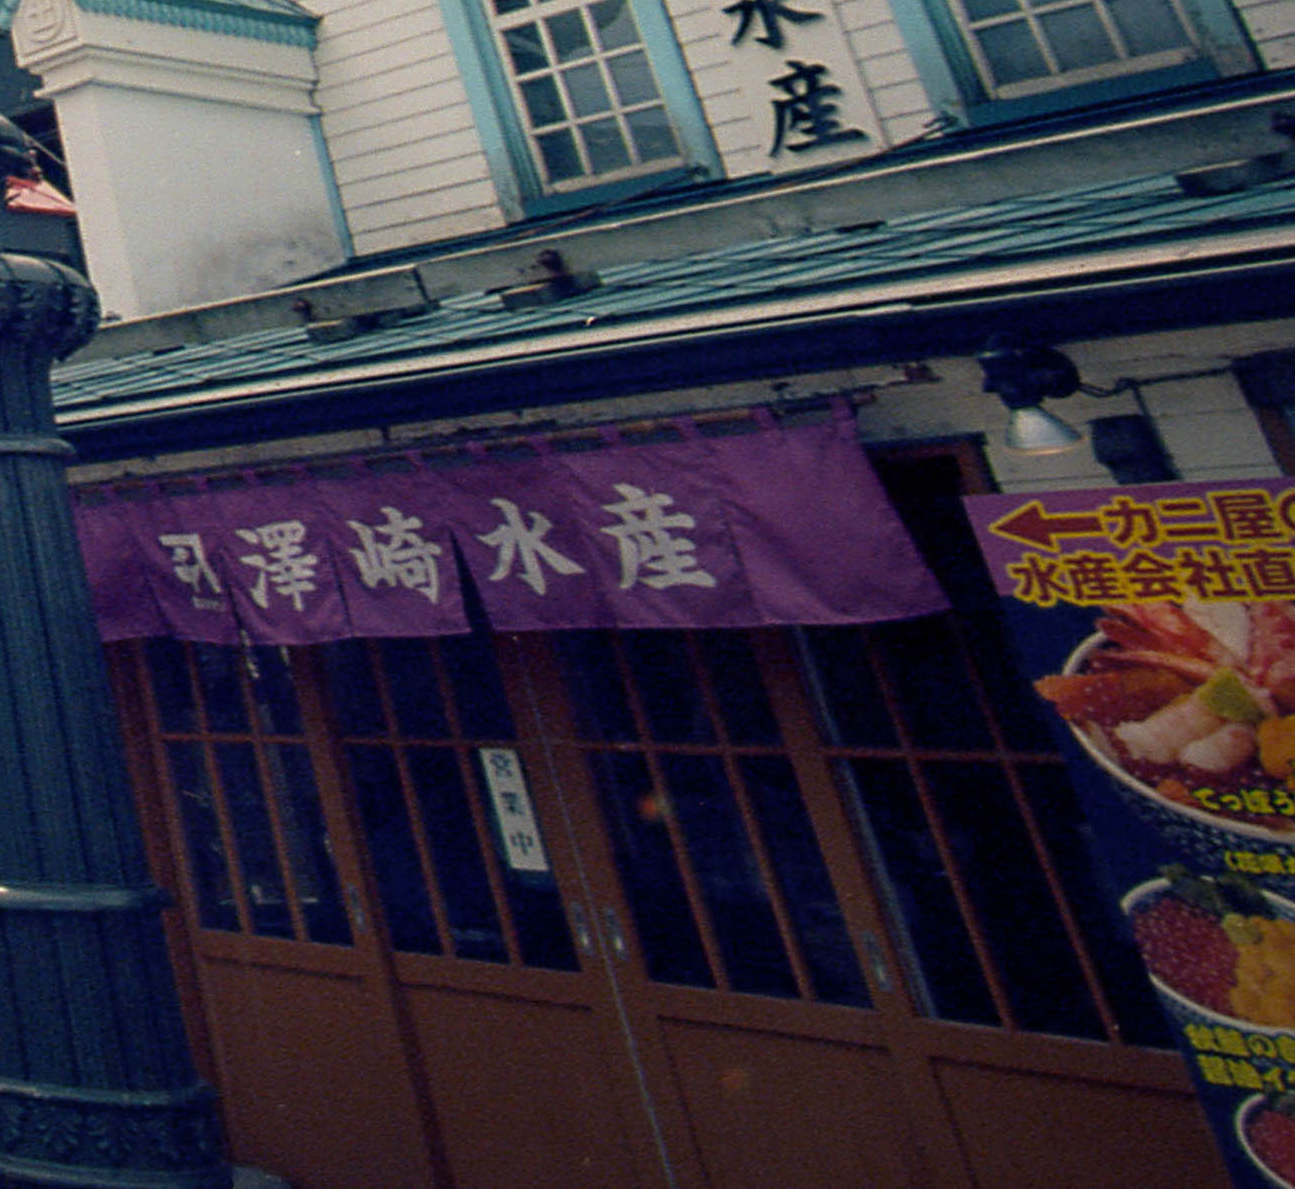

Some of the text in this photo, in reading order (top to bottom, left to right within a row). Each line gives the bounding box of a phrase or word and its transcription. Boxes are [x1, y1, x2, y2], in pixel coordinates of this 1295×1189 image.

[238, 483, 717, 610] 澤崎水産
[1006, 545, 1295, 606] 水産会社直
